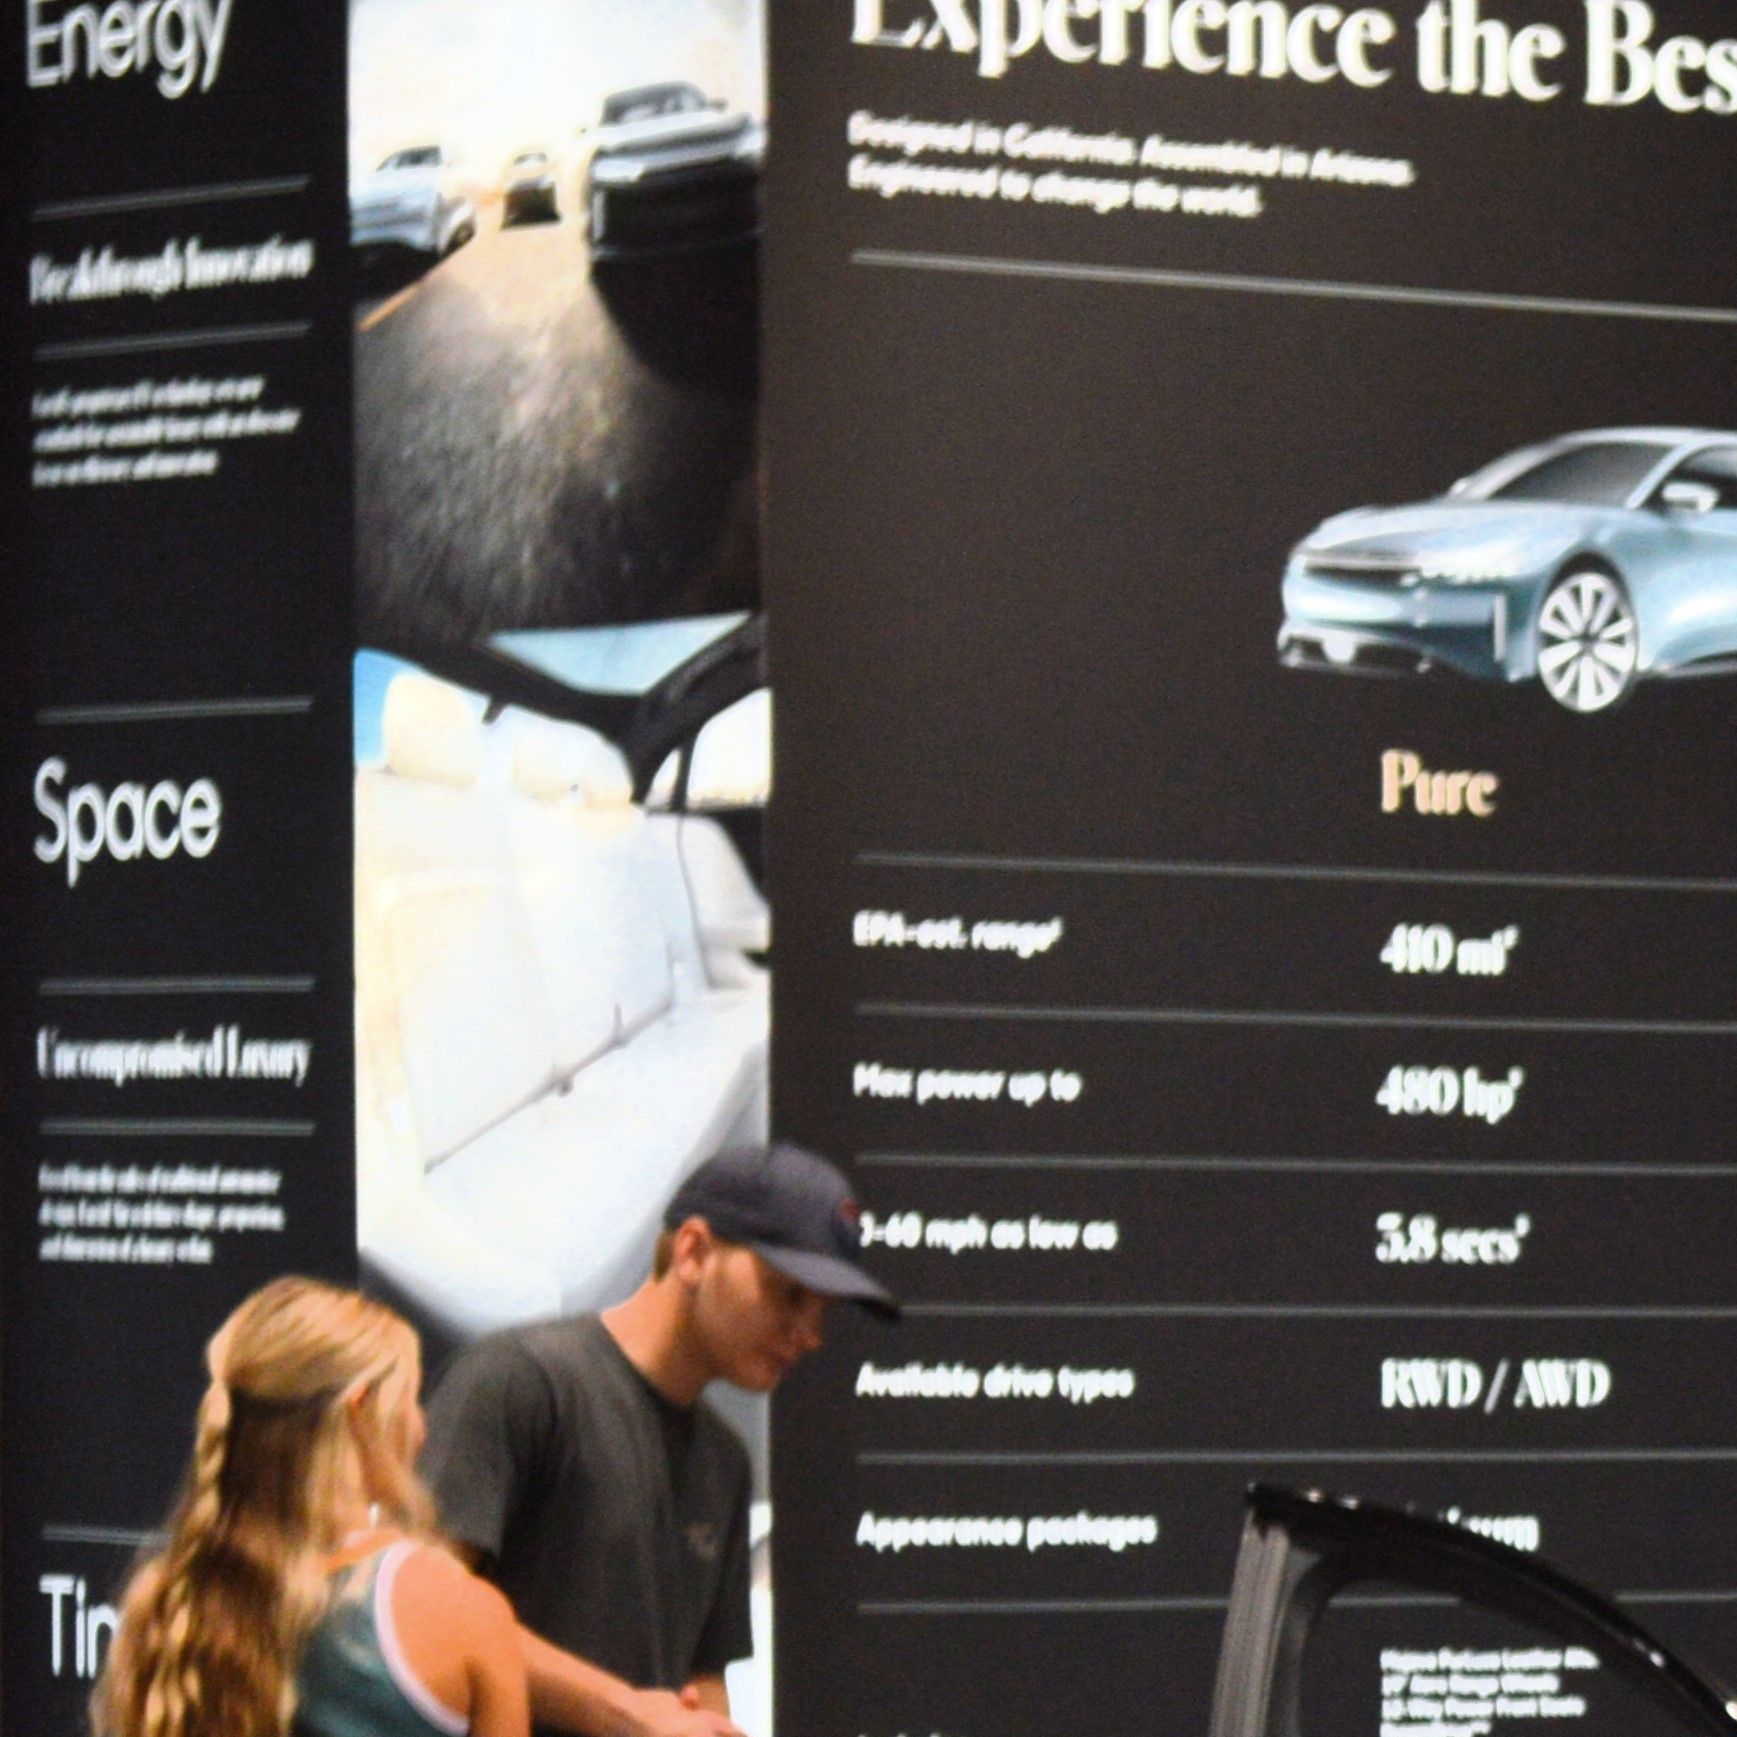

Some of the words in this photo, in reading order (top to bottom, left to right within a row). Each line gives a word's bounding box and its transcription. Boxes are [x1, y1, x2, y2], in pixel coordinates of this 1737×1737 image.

[28, 0, 231, 98] Energy
[1416, 0, 1564, 101] the
[1381, 750, 1497, 816] Pure
[35, 758, 221, 886] Space
[1008, 1072, 1048, 1106] up
[1049, 1070, 1082, 1101] to
[1376, 1066, 1460, 1114] 480
[1028, 1216, 1080, 1249] low
[856, 1363, 980, 1398] Available
[983, 1365, 1054, 1397] drive
[1057, 1367, 1135, 1403] types
[1514, 1359, 1611, 1408] AWD
